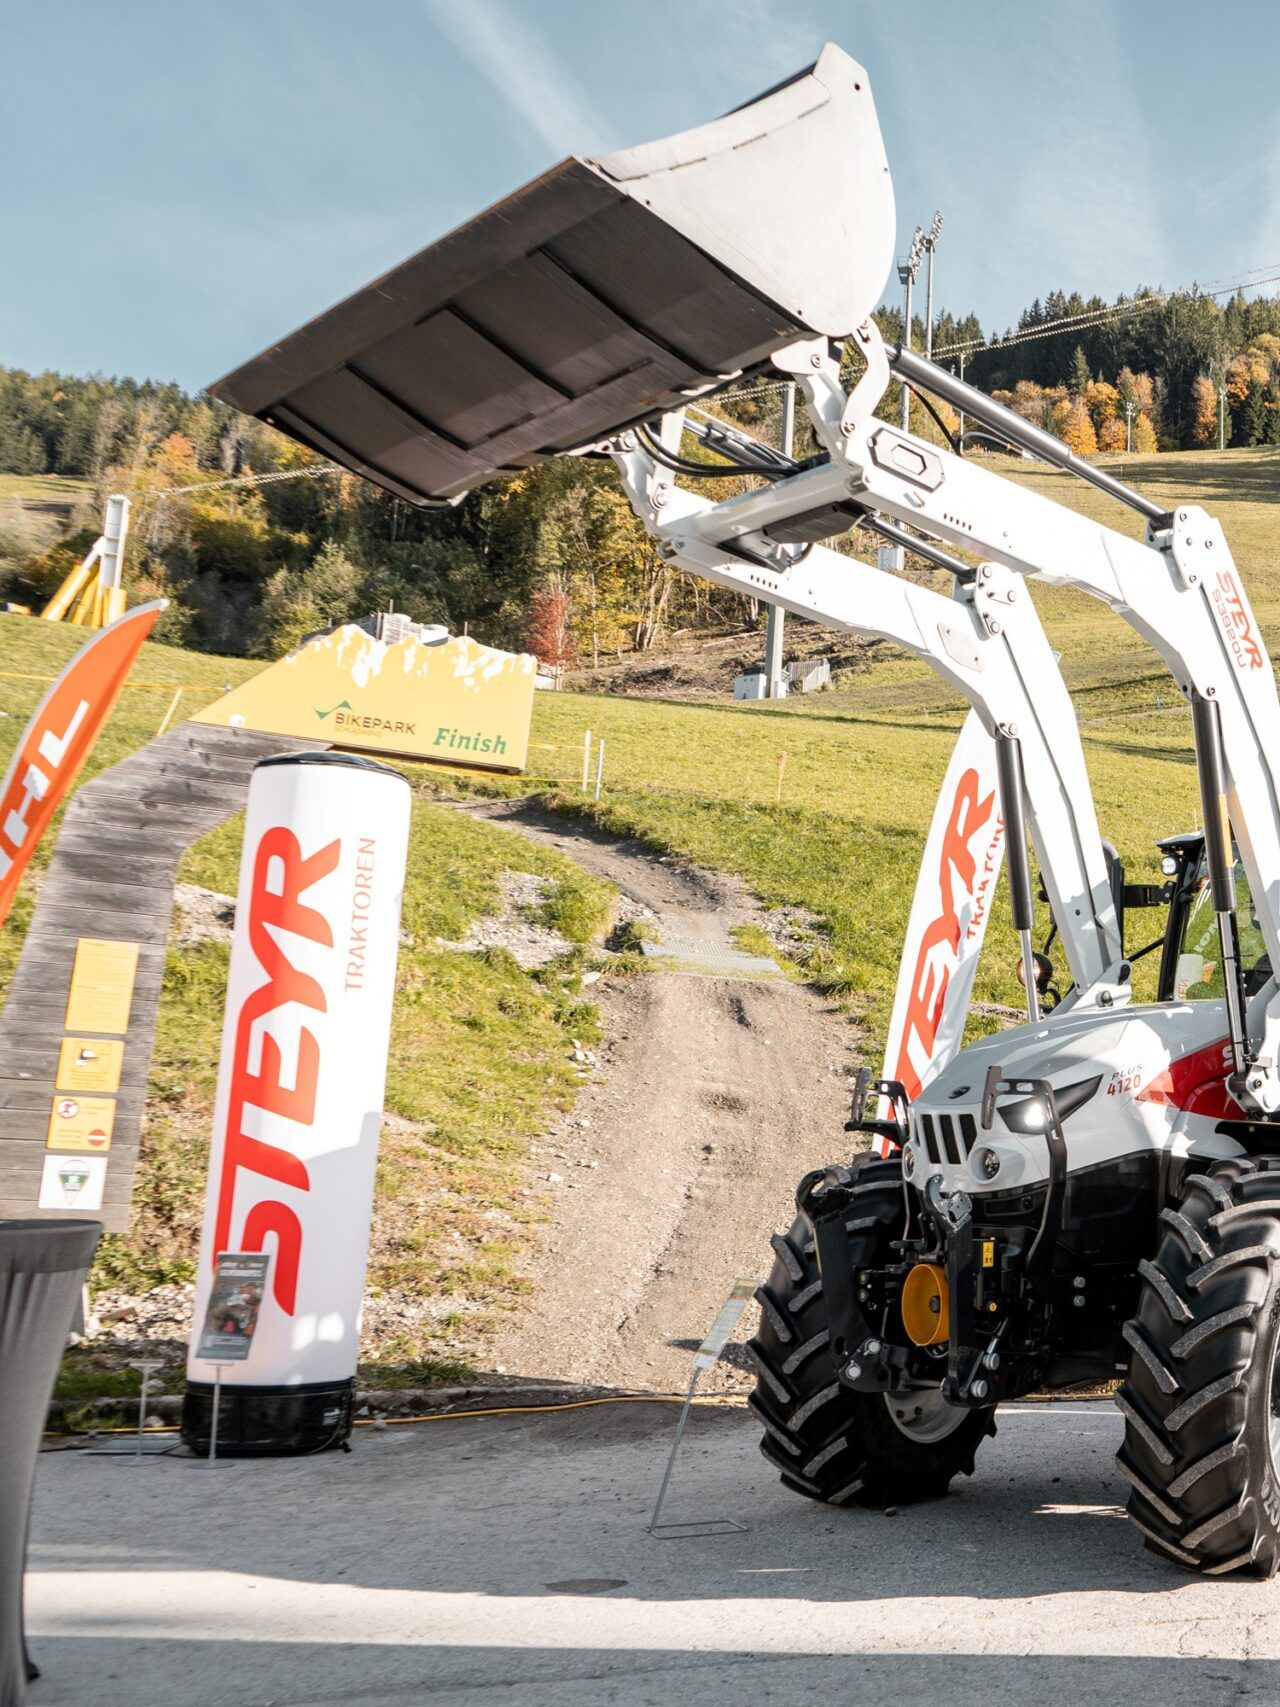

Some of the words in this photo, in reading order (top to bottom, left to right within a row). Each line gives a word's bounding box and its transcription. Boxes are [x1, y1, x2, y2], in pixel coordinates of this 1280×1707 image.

[1216, 570, 1264, 670] STEYR
[335, 712, 417, 736] BIKEPARK
[433, 727, 507, 755] Finish
[343, 837, 377, 993] TRAKTOREN
[879, 768, 996, 1160] TEYR
[212, 826, 341, 1318] STEYR
[1106, 1074, 1141, 1096] 4120
[1111, 1063, 1143, 1081] PLUS
